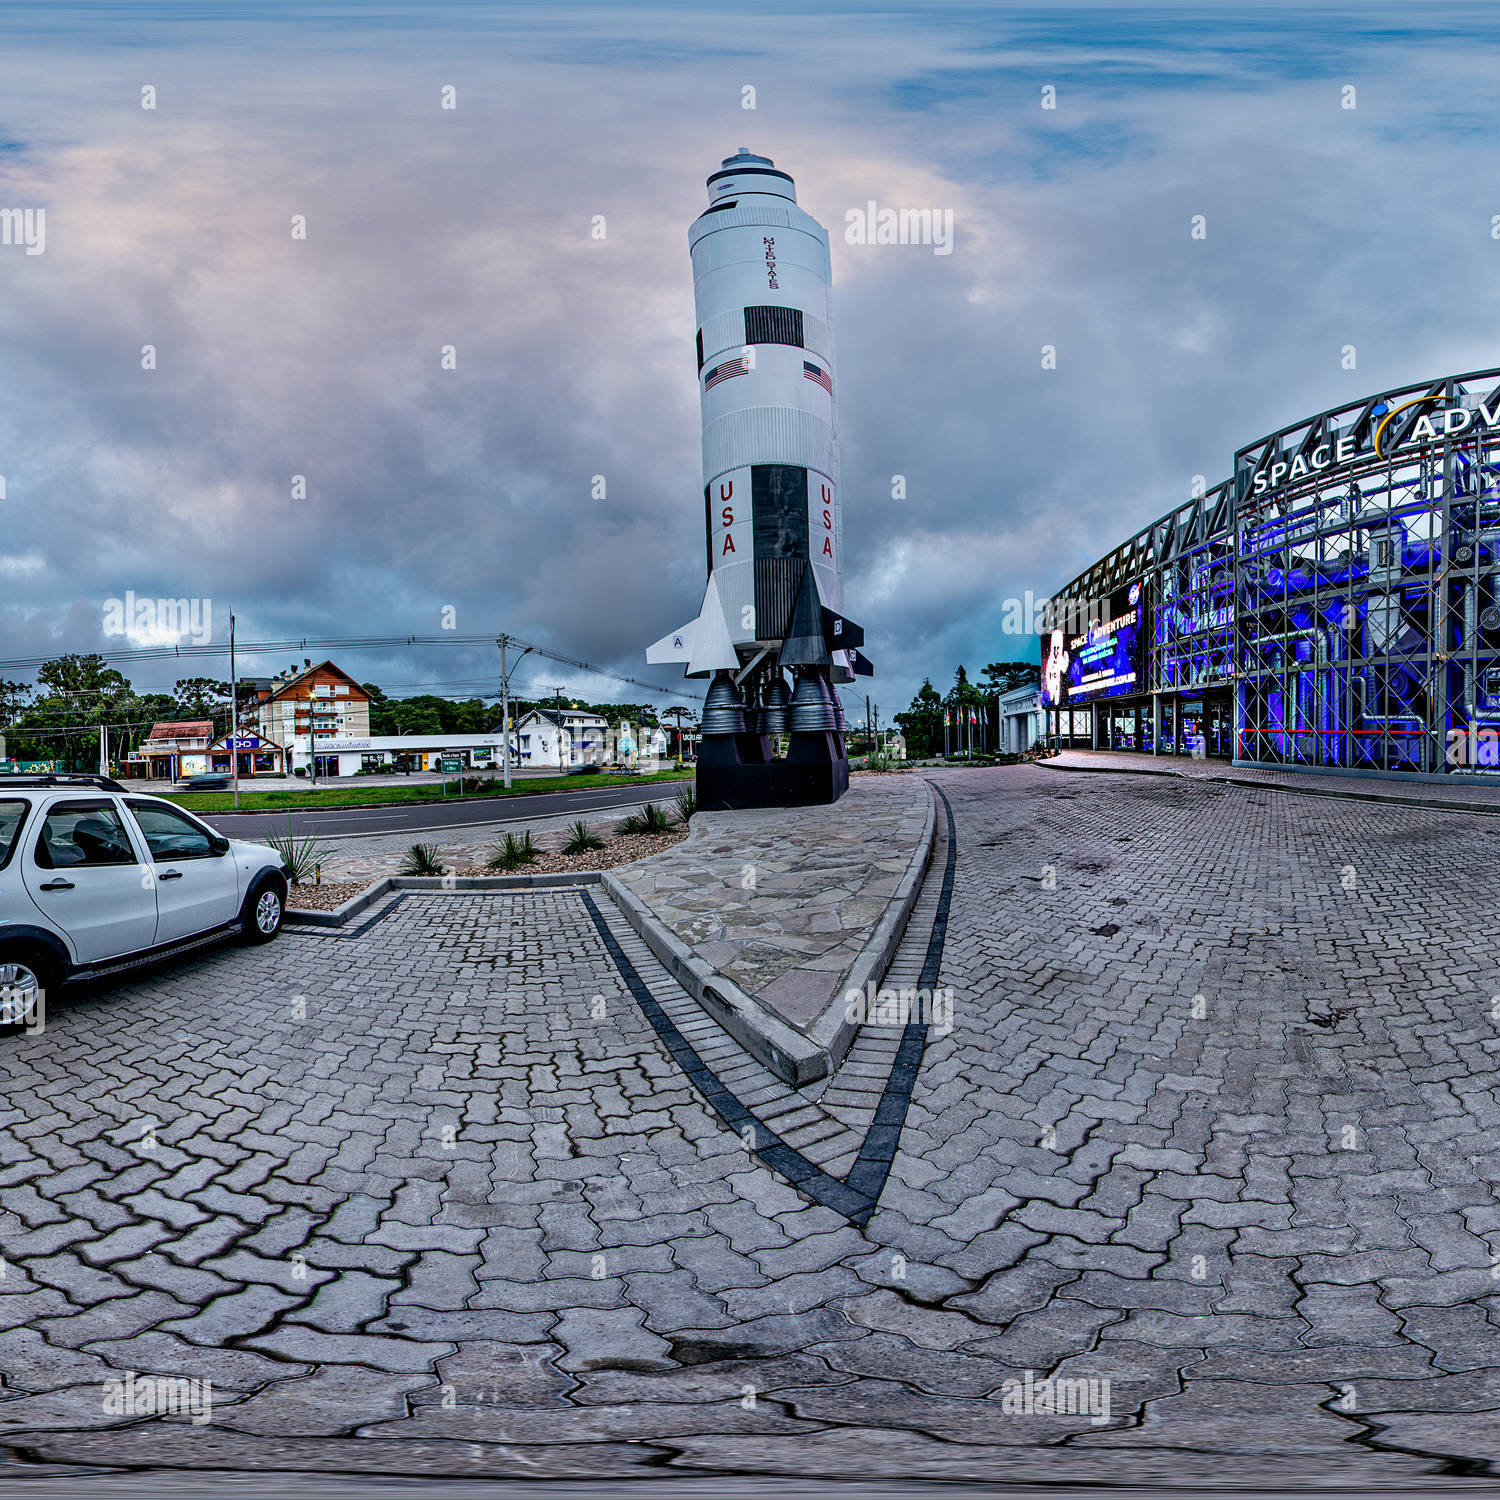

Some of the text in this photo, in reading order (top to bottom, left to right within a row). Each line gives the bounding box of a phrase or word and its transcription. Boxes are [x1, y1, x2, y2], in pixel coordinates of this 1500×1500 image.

[1253, 435, 1356, 494] SPACE
[720, 481, 736, 556] USA
[822, 484, 832, 558] USA
[1071, 611, 1136, 650] SPACE ADVENTURE
